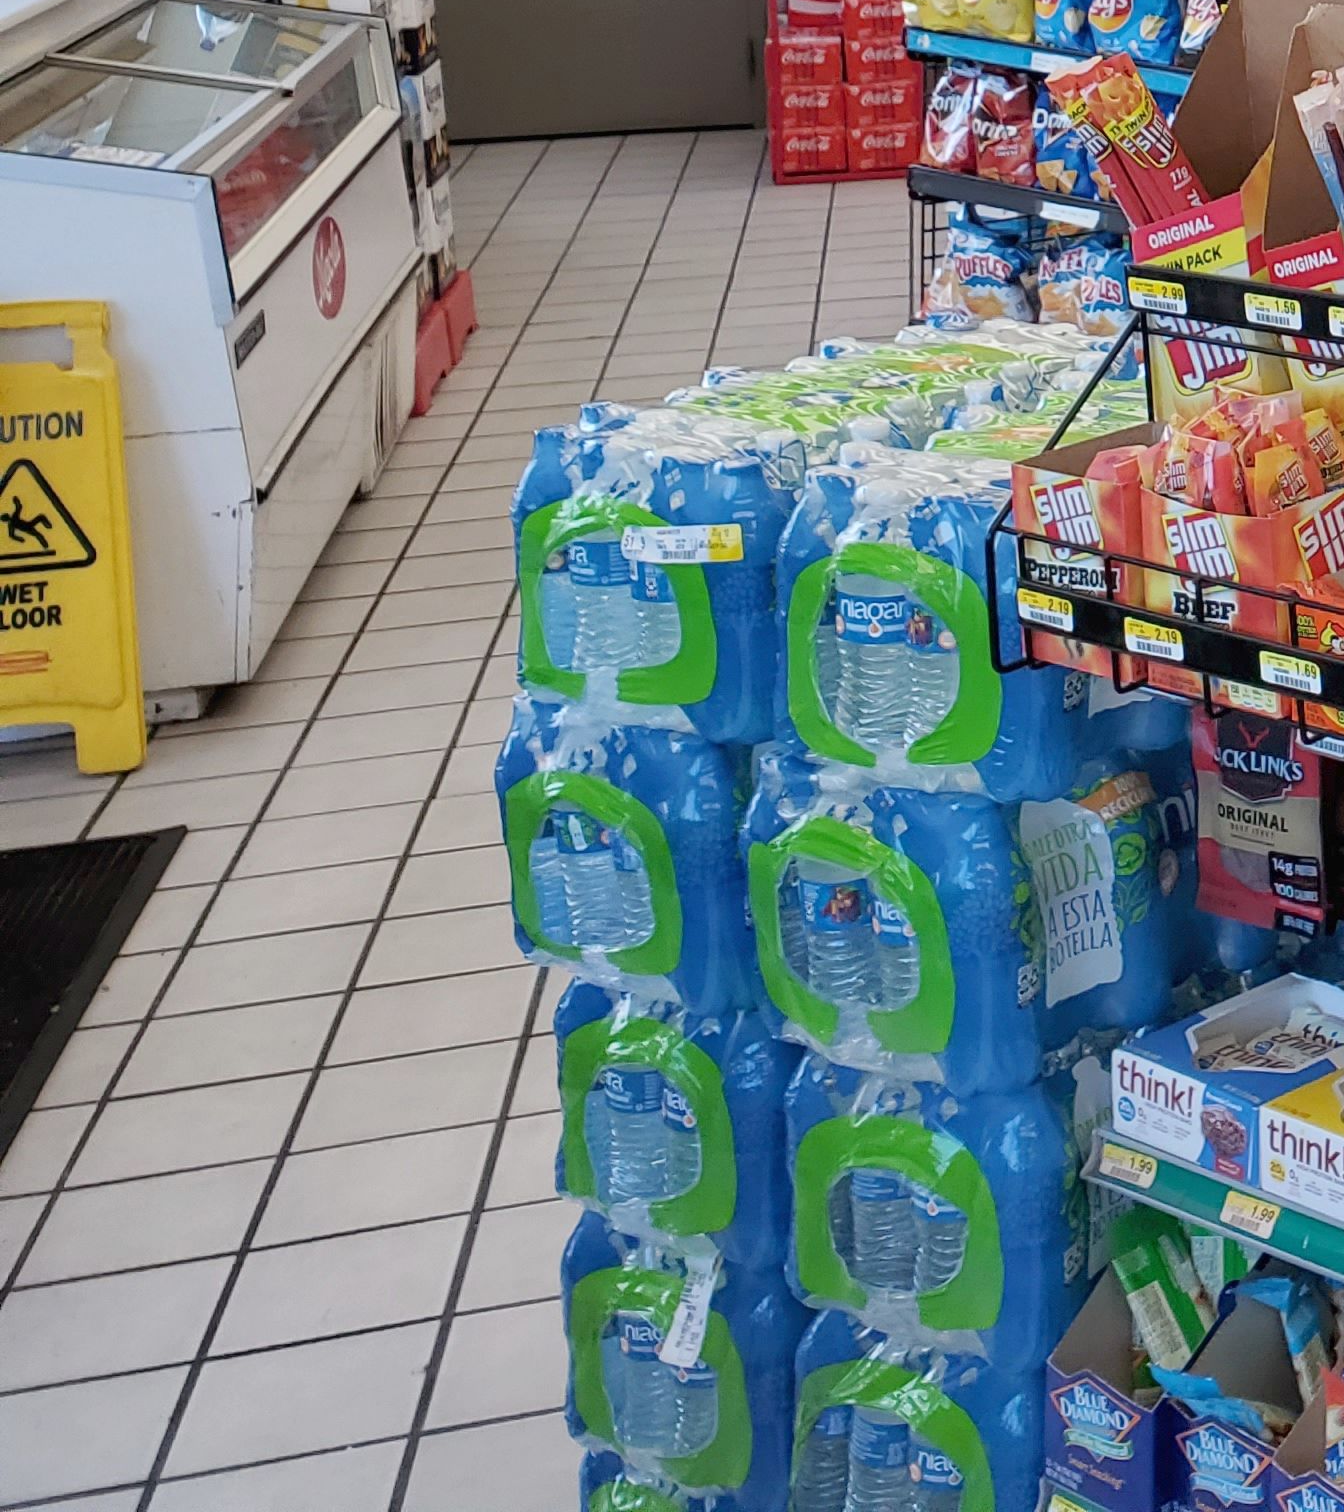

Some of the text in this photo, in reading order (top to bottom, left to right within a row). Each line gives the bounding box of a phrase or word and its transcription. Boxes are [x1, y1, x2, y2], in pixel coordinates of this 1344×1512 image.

[782, 49, 827, 64] Coca-Cola
[785, 91, 830, 108] Coca-Cola
[1148, 215, 1215, 250] ORIGINAL
[955, 252, 1011, 281] RUFFLES
[1186, 244, 1223, 269] PACK
[1161, 285, 1183, 301] 2.99
[1274, 299, 1296, 316] 1.59
[0, 410, 83, 443] UTION
[1037, 480, 1092, 524] slim
[1168, 514, 1226, 554] slim
[0, 581, 48, 605] WET
[0, 605, 62, 630] LOOR
[839, 594, 906, 638] niagar
[1048, 599, 1070, 616] 2.19
[1155, 628, 1178, 645] 2.19
[1293, 662, 1318, 680] 1.69
[1037, 842, 1104, 903] VIDA
[1270, 856, 1293, 876] 14g
[1062, 889, 1106, 931] ESTA
[1117, 1055, 1195, 1120] think!
[1129, 1156, 1153, 1174] 1.99
[1251, 1204, 1276, 1224] 1.99
[1073, 1387, 1108, 1412] BLUE
[1060, 1399, 1129, 1430] DIAMOND
[1201, 1431, 1236, 1459] BLUE
[1185, 1442, 1261, 1474] DIAMOND
